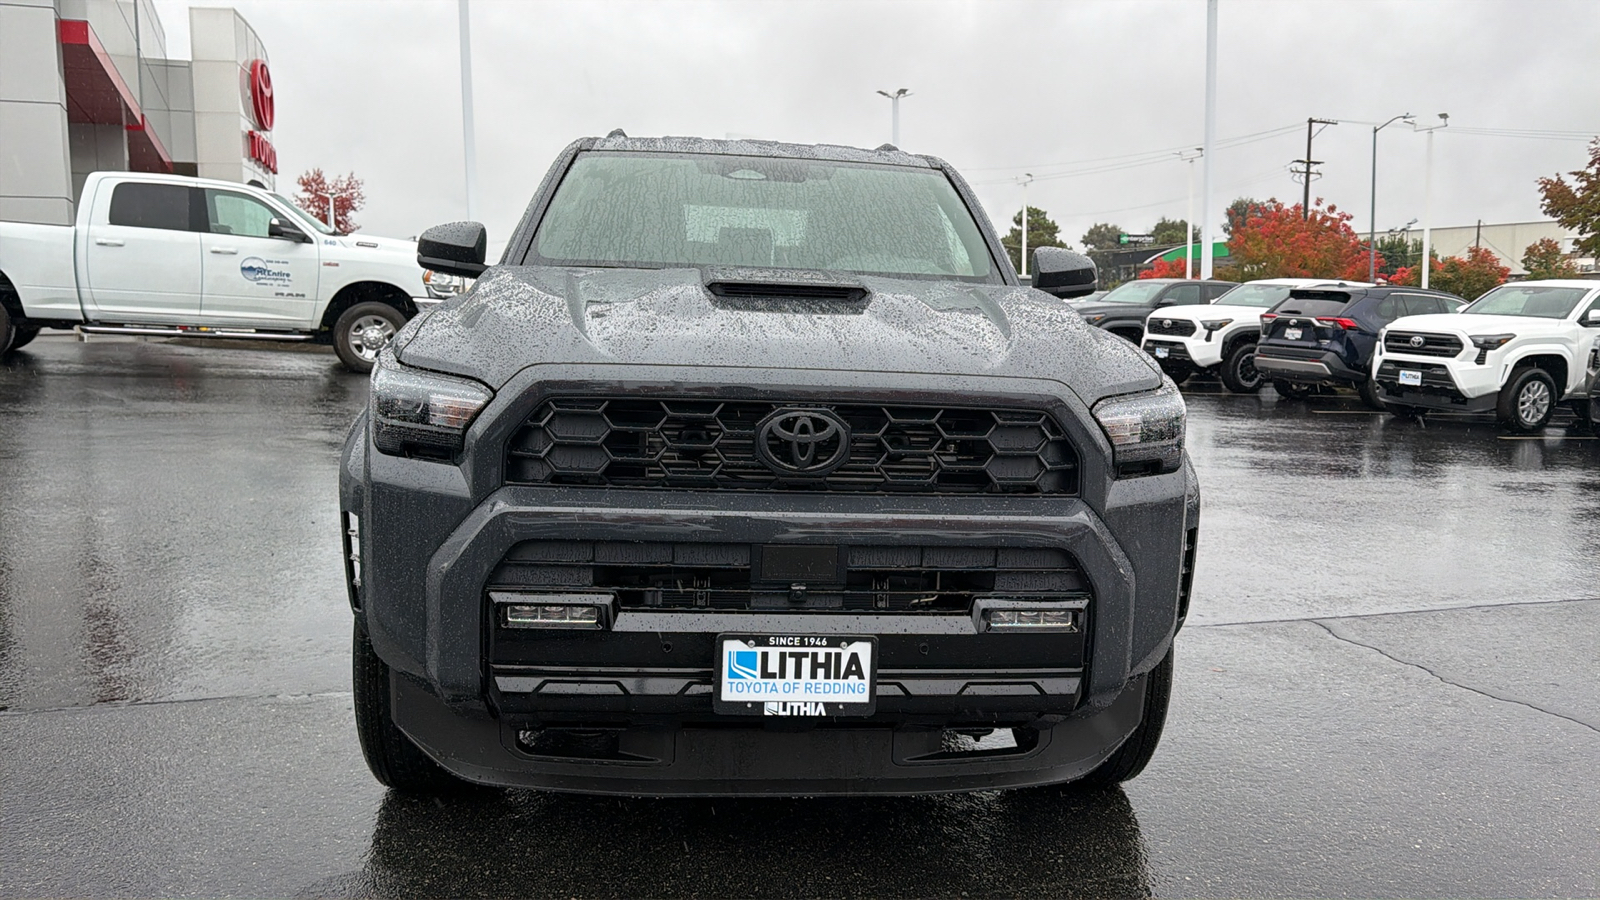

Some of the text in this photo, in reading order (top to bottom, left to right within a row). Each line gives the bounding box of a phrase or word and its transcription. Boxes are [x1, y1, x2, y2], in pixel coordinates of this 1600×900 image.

[769, 637, 828, 646] SINCE 1946
[760, 651, 865, 680] LITHIA
[727, 681, 866, 694] TOYOTA OF REDDING
[779, 701, 827, 716] LITHIA
